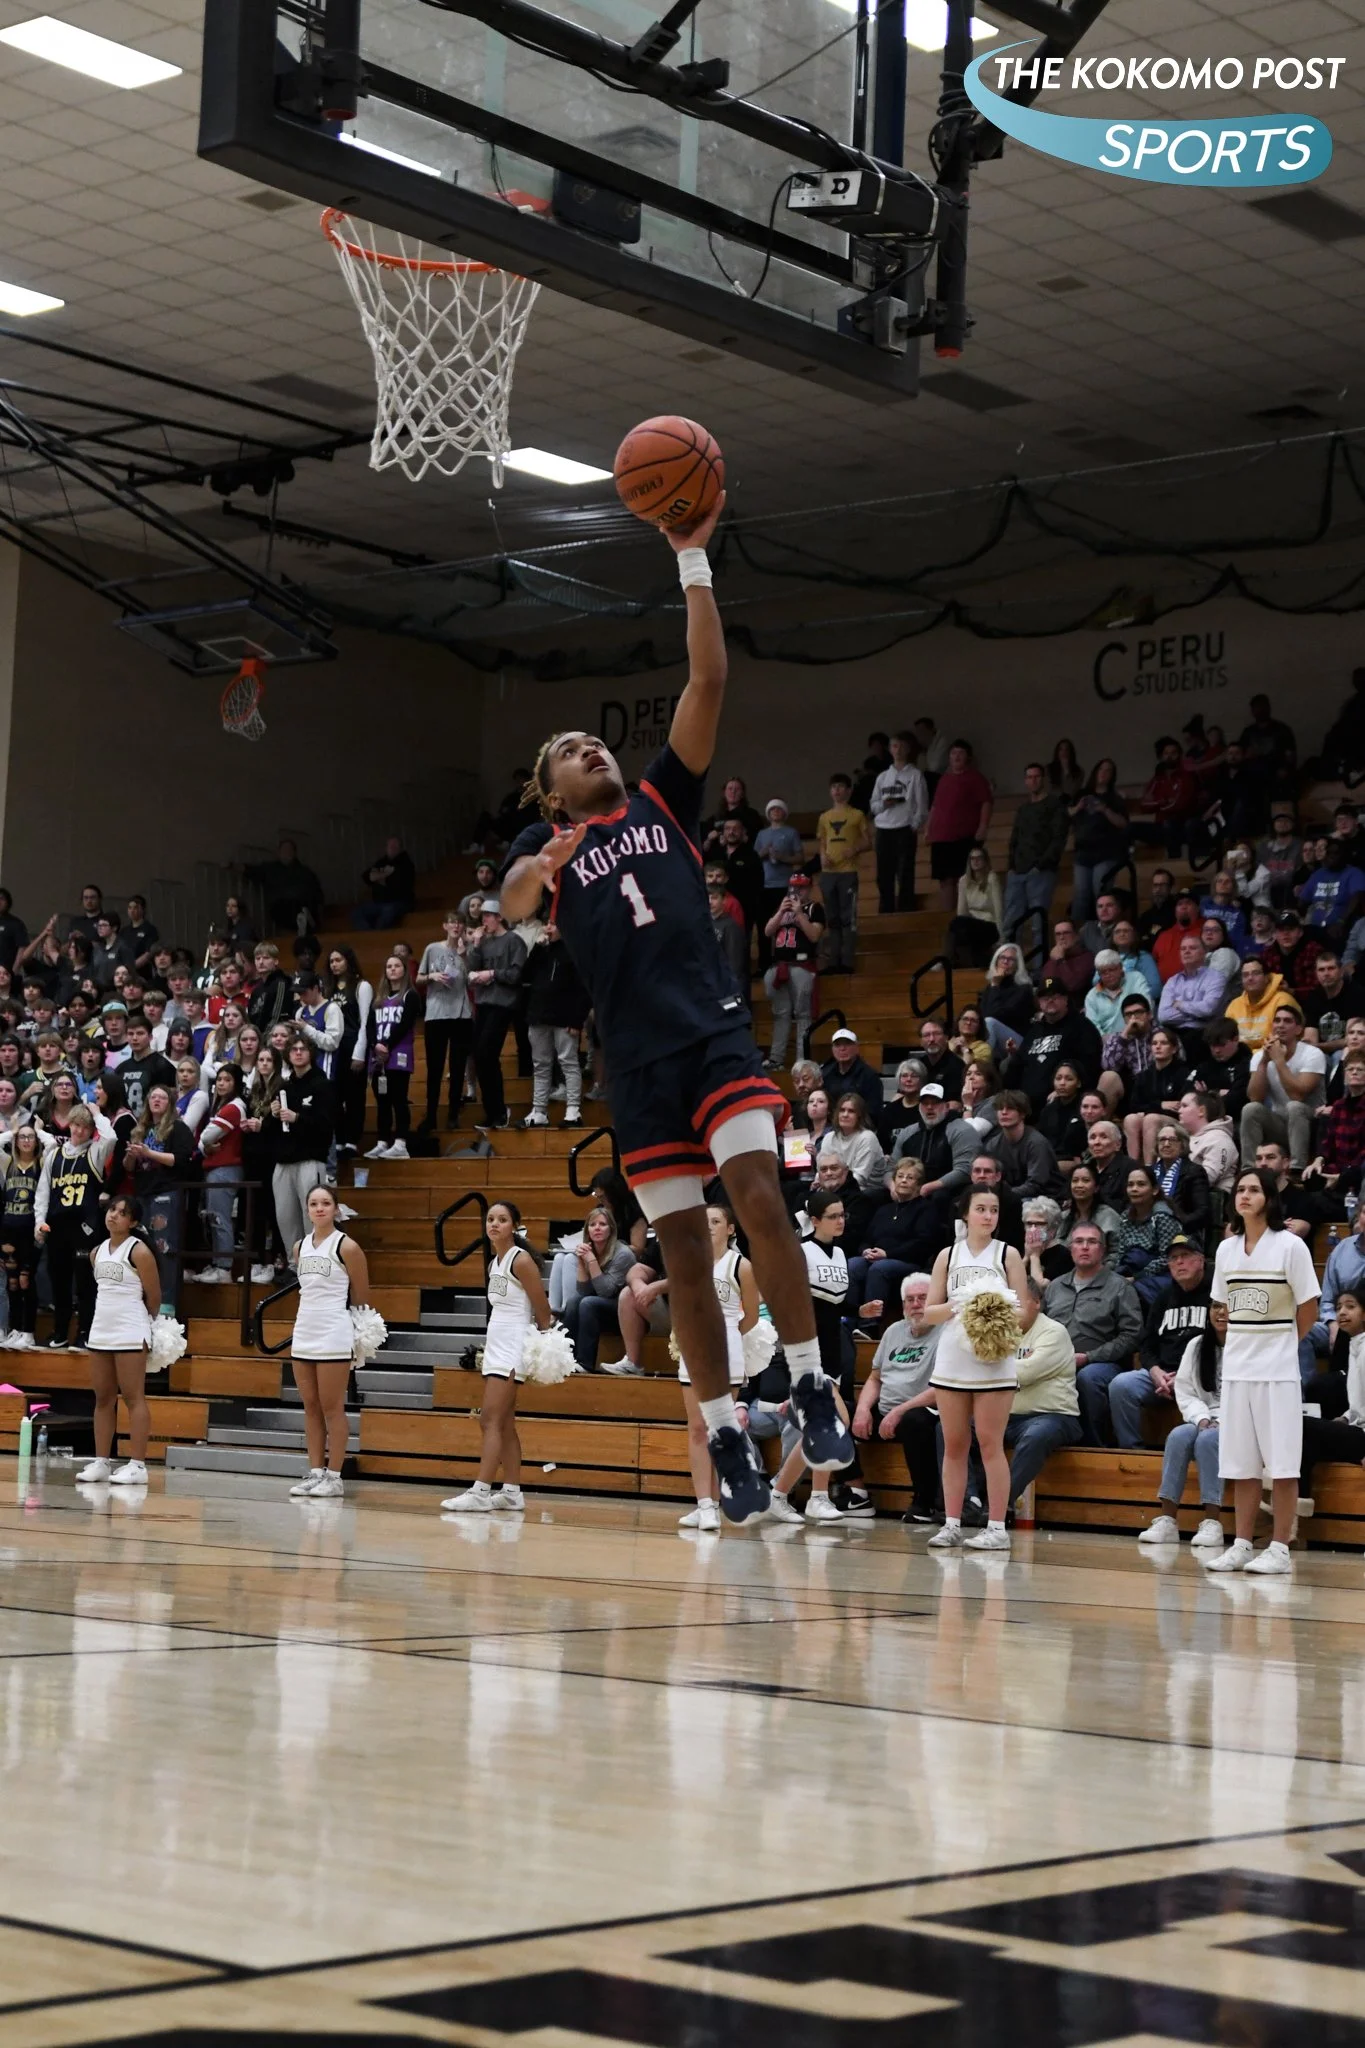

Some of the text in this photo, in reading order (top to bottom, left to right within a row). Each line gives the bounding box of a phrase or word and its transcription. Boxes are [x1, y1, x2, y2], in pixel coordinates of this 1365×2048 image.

[1138, 631, 1224, 670] PERU
[1094, 641, 1128, 701] C
[1132, 664, 1228, 696] STUDENTS
[601, 700, 628, 754] D
[571, 824, 668, 887] KOKOMO
[619, 872, 656, 928] 1
[375, 1006, 404, 1024] UCKS
[60, 1185, 86, 1207] 31
[818, 1264, 848, 1284] PHS
[1228, 1287, 1270, 1314] TIGERS
[1158, 1306, 1208, 1336] PURDU
